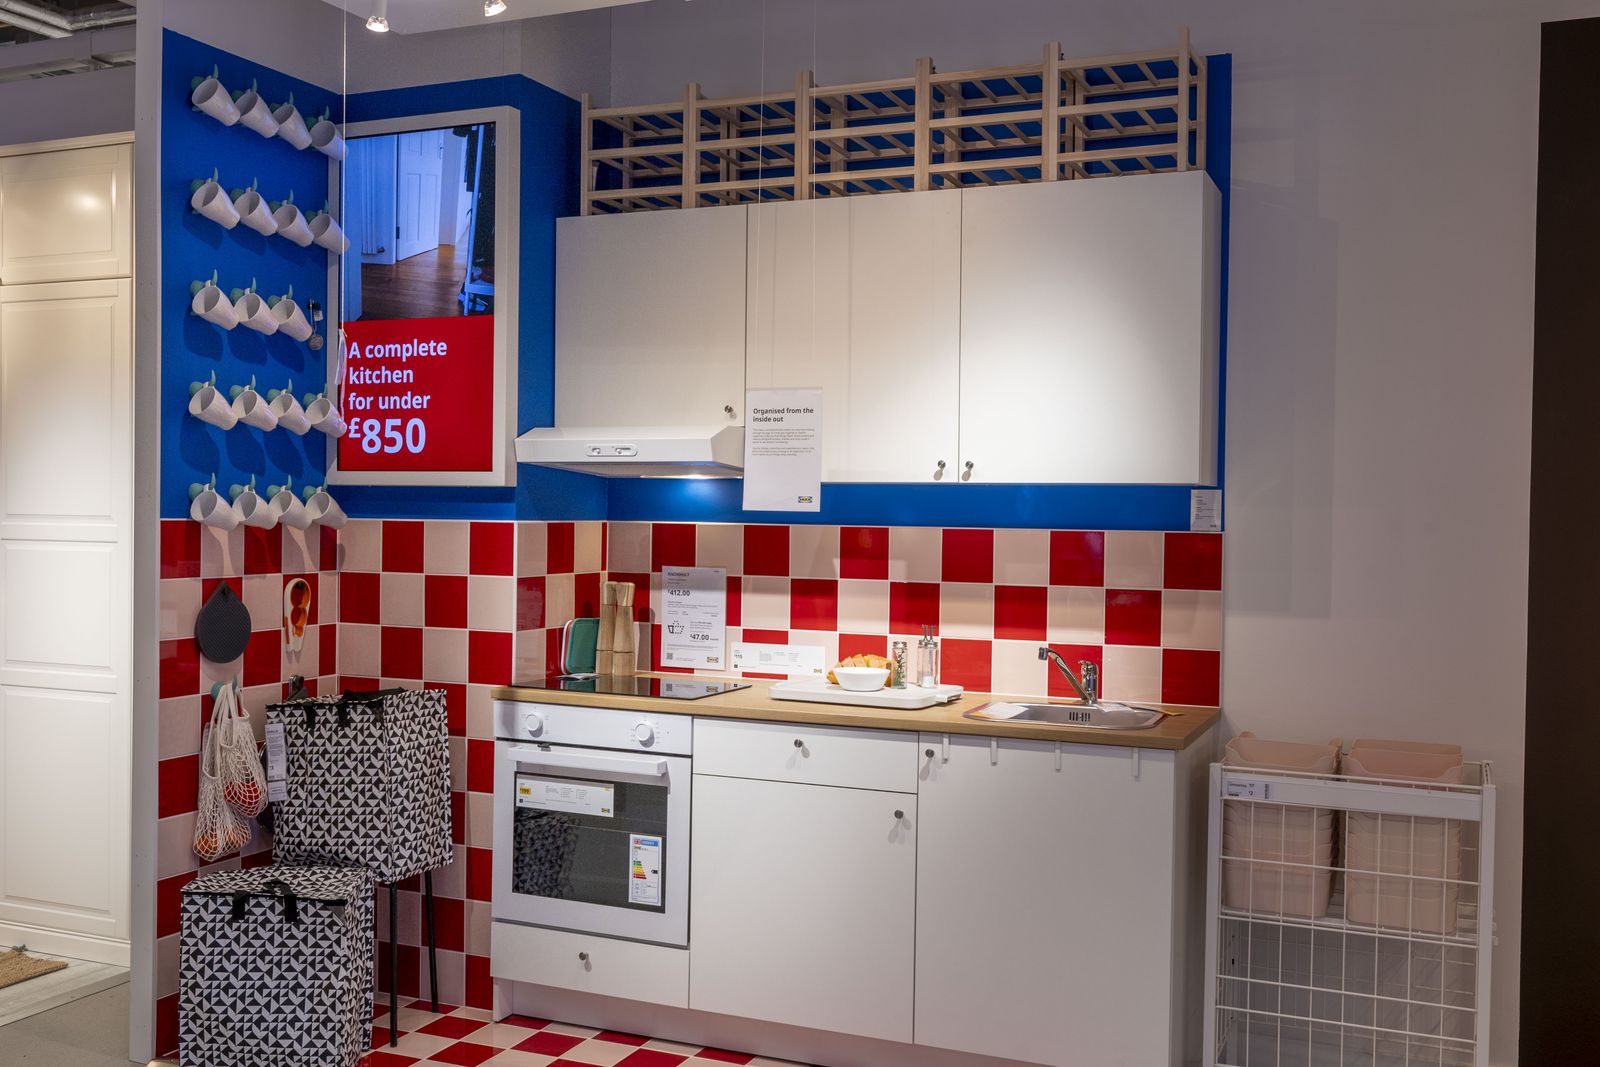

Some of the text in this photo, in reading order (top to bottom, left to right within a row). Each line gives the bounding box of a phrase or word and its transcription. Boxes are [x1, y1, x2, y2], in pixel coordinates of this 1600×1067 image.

[348, 339, 448, 362] A complete
[349, 366, 414, 385] kitchen
[348, 391, 431, 410] for under
[348, 417, 426, 454] £850
